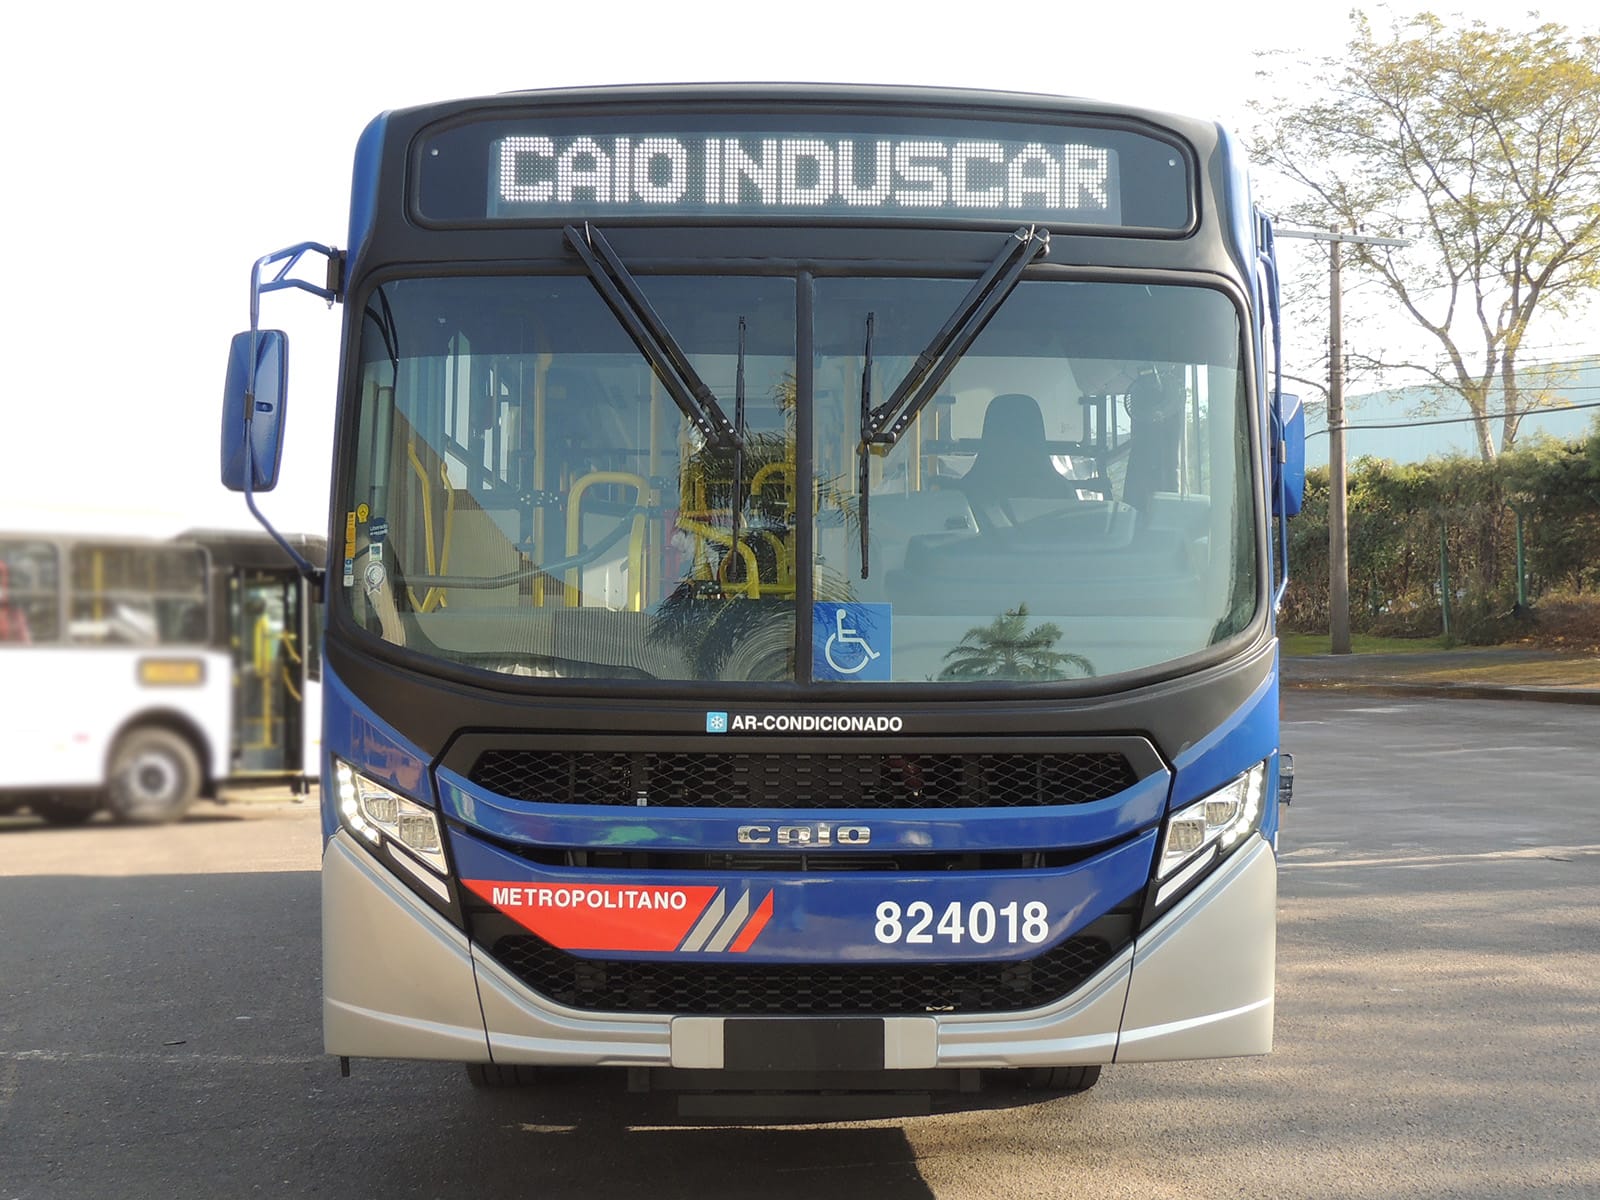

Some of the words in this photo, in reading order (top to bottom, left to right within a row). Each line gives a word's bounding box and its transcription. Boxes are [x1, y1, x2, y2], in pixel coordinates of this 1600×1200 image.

[500, 136, 687, 203] CAIO
[705, 138, 1107, 208] INDUSCAR
[731, 715, 903, 732] AR-CONDICIONADO
[492, 887, 687, 910] METROPOLITANO
[874, 901, 1049, 944] 824018
